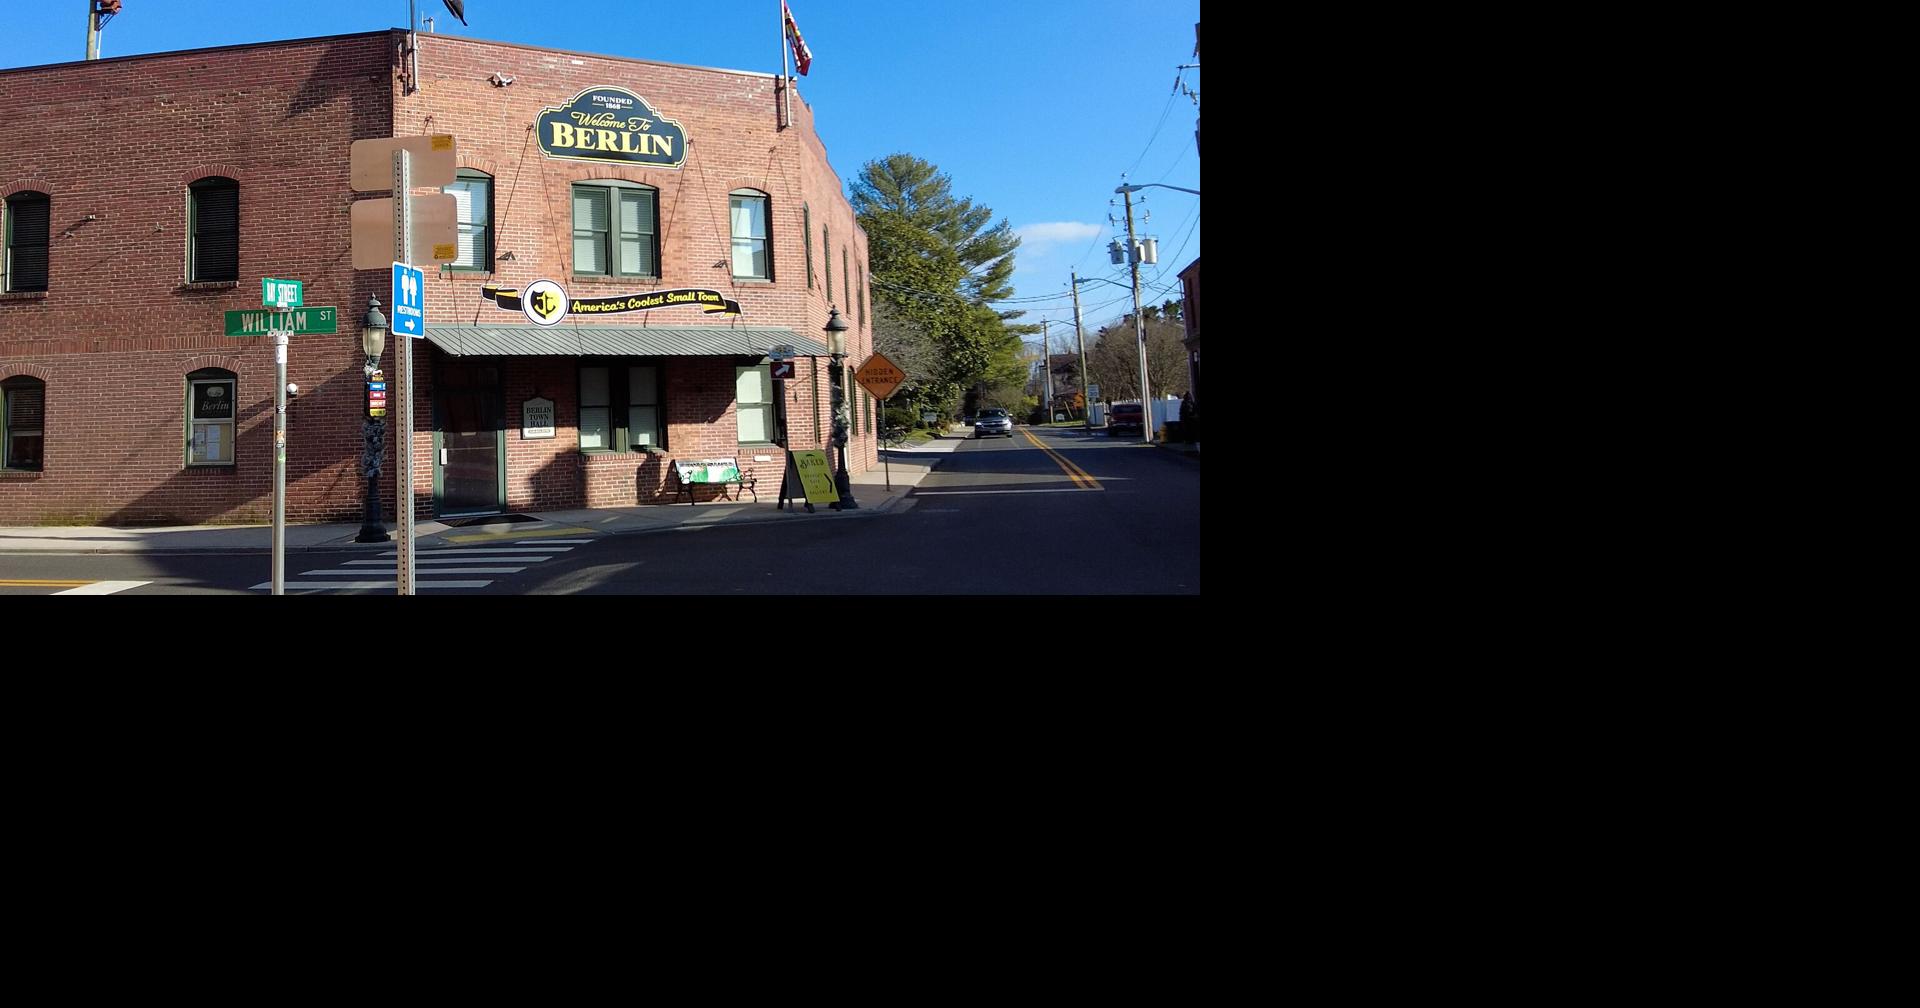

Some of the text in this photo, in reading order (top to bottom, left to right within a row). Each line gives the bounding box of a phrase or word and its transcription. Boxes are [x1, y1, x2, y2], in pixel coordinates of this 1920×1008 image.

[592, 95, 633, 105] FOUNDED
[570, 111, 653, 131] Welcome To
[550, 121, 674, 157] BERLIN
[572, 291, 720, 313] America's Coolest Small Town
[241, 310, 332, 332] WILLIAM ST
[865, 367, 894, 376] HIDDEN
[861, 376, 897, 384] ENTRANCE
[202, 401, 229, 411] Berlin
[526, 406, 552, 414] BERLIN
[530, 420, 549, 428] HALL
